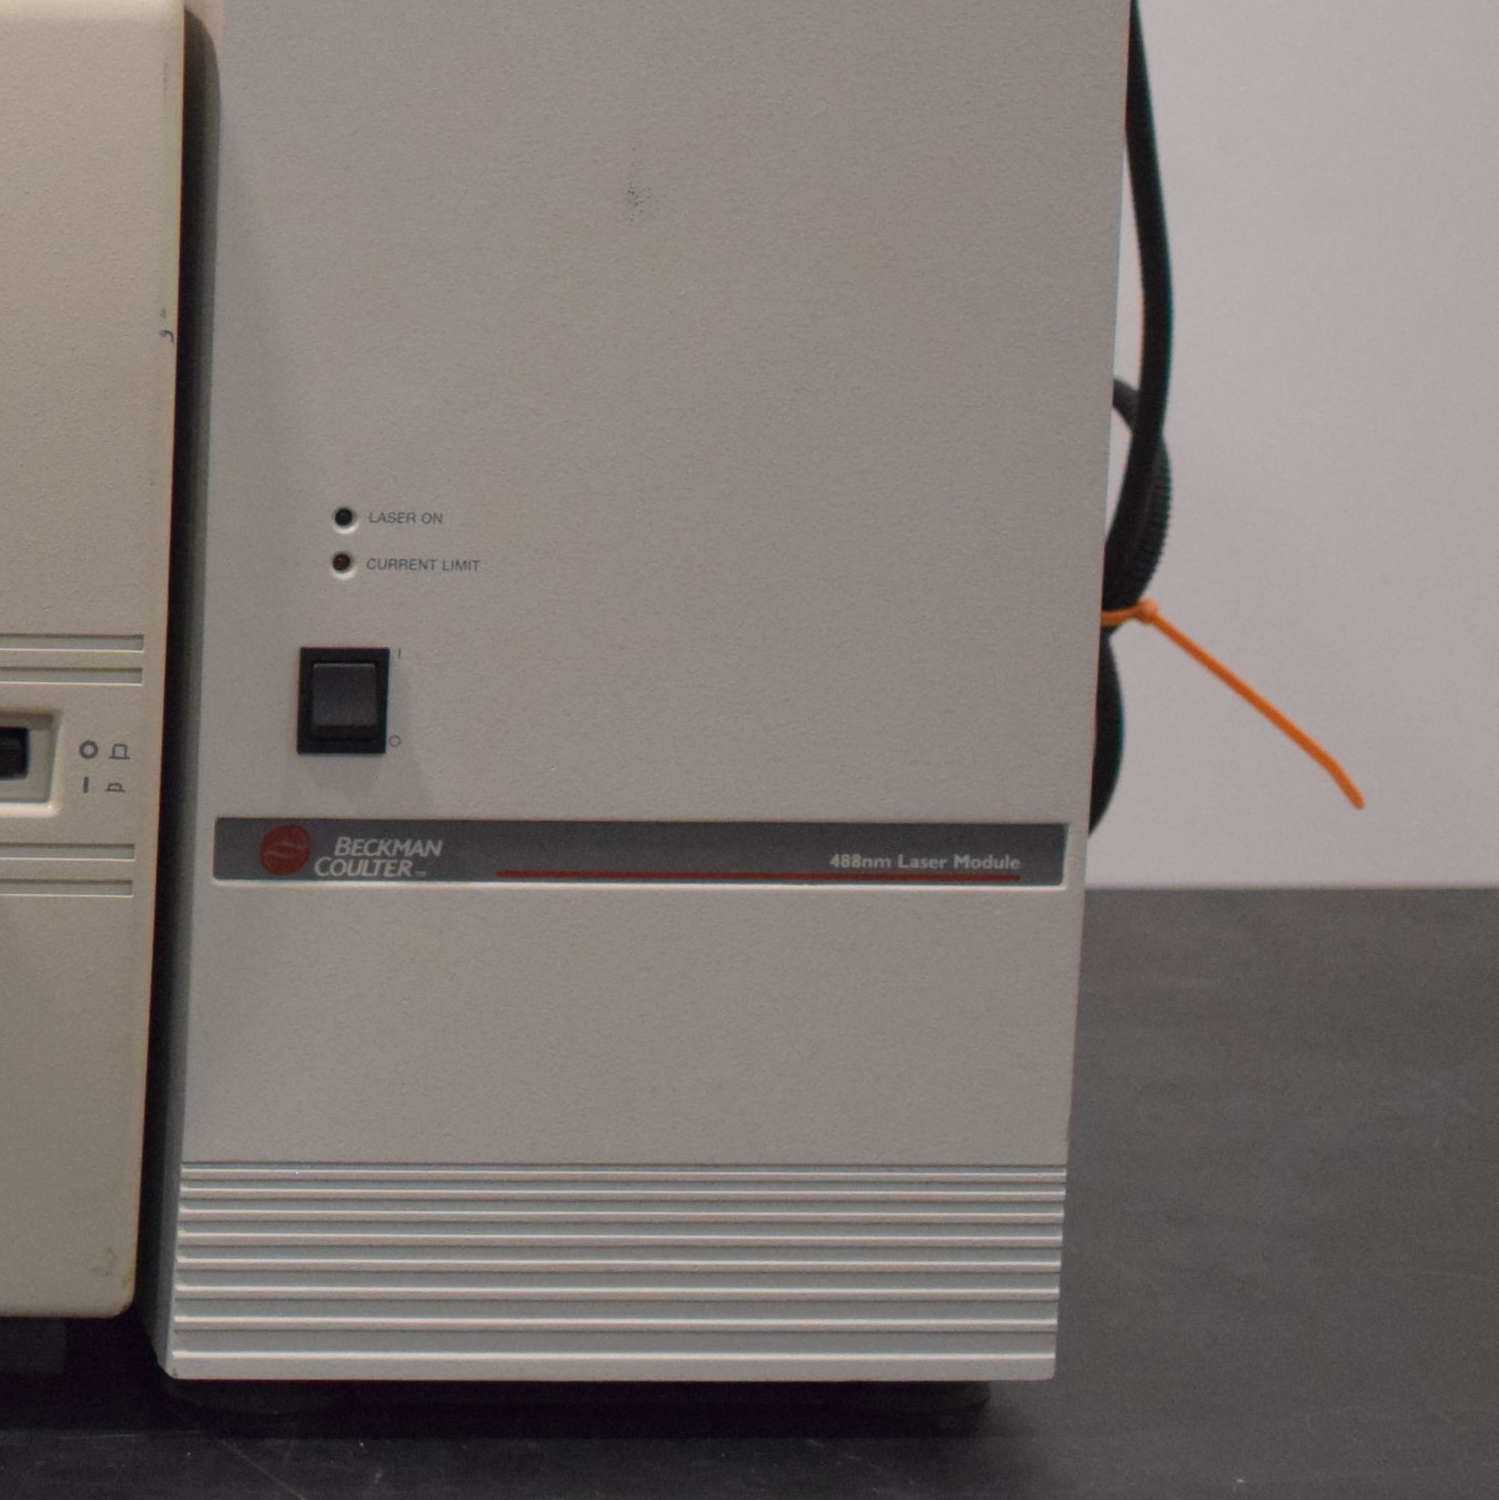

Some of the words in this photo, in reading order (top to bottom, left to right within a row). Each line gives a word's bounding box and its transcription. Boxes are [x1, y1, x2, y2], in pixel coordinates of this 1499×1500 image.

[368, 512, 416, 523] LASER
[421, 512, 443, 524] ON
[366, 558, 437, 571] CURRENT
[442, 560, 480, 572] LIMIT
[333, 836, 442, 857] BECKMAN
[829, 853, 892, 869] 488nm
[897, 854, 947, 869] Laser
[953, 854, 1021, 870] Module
